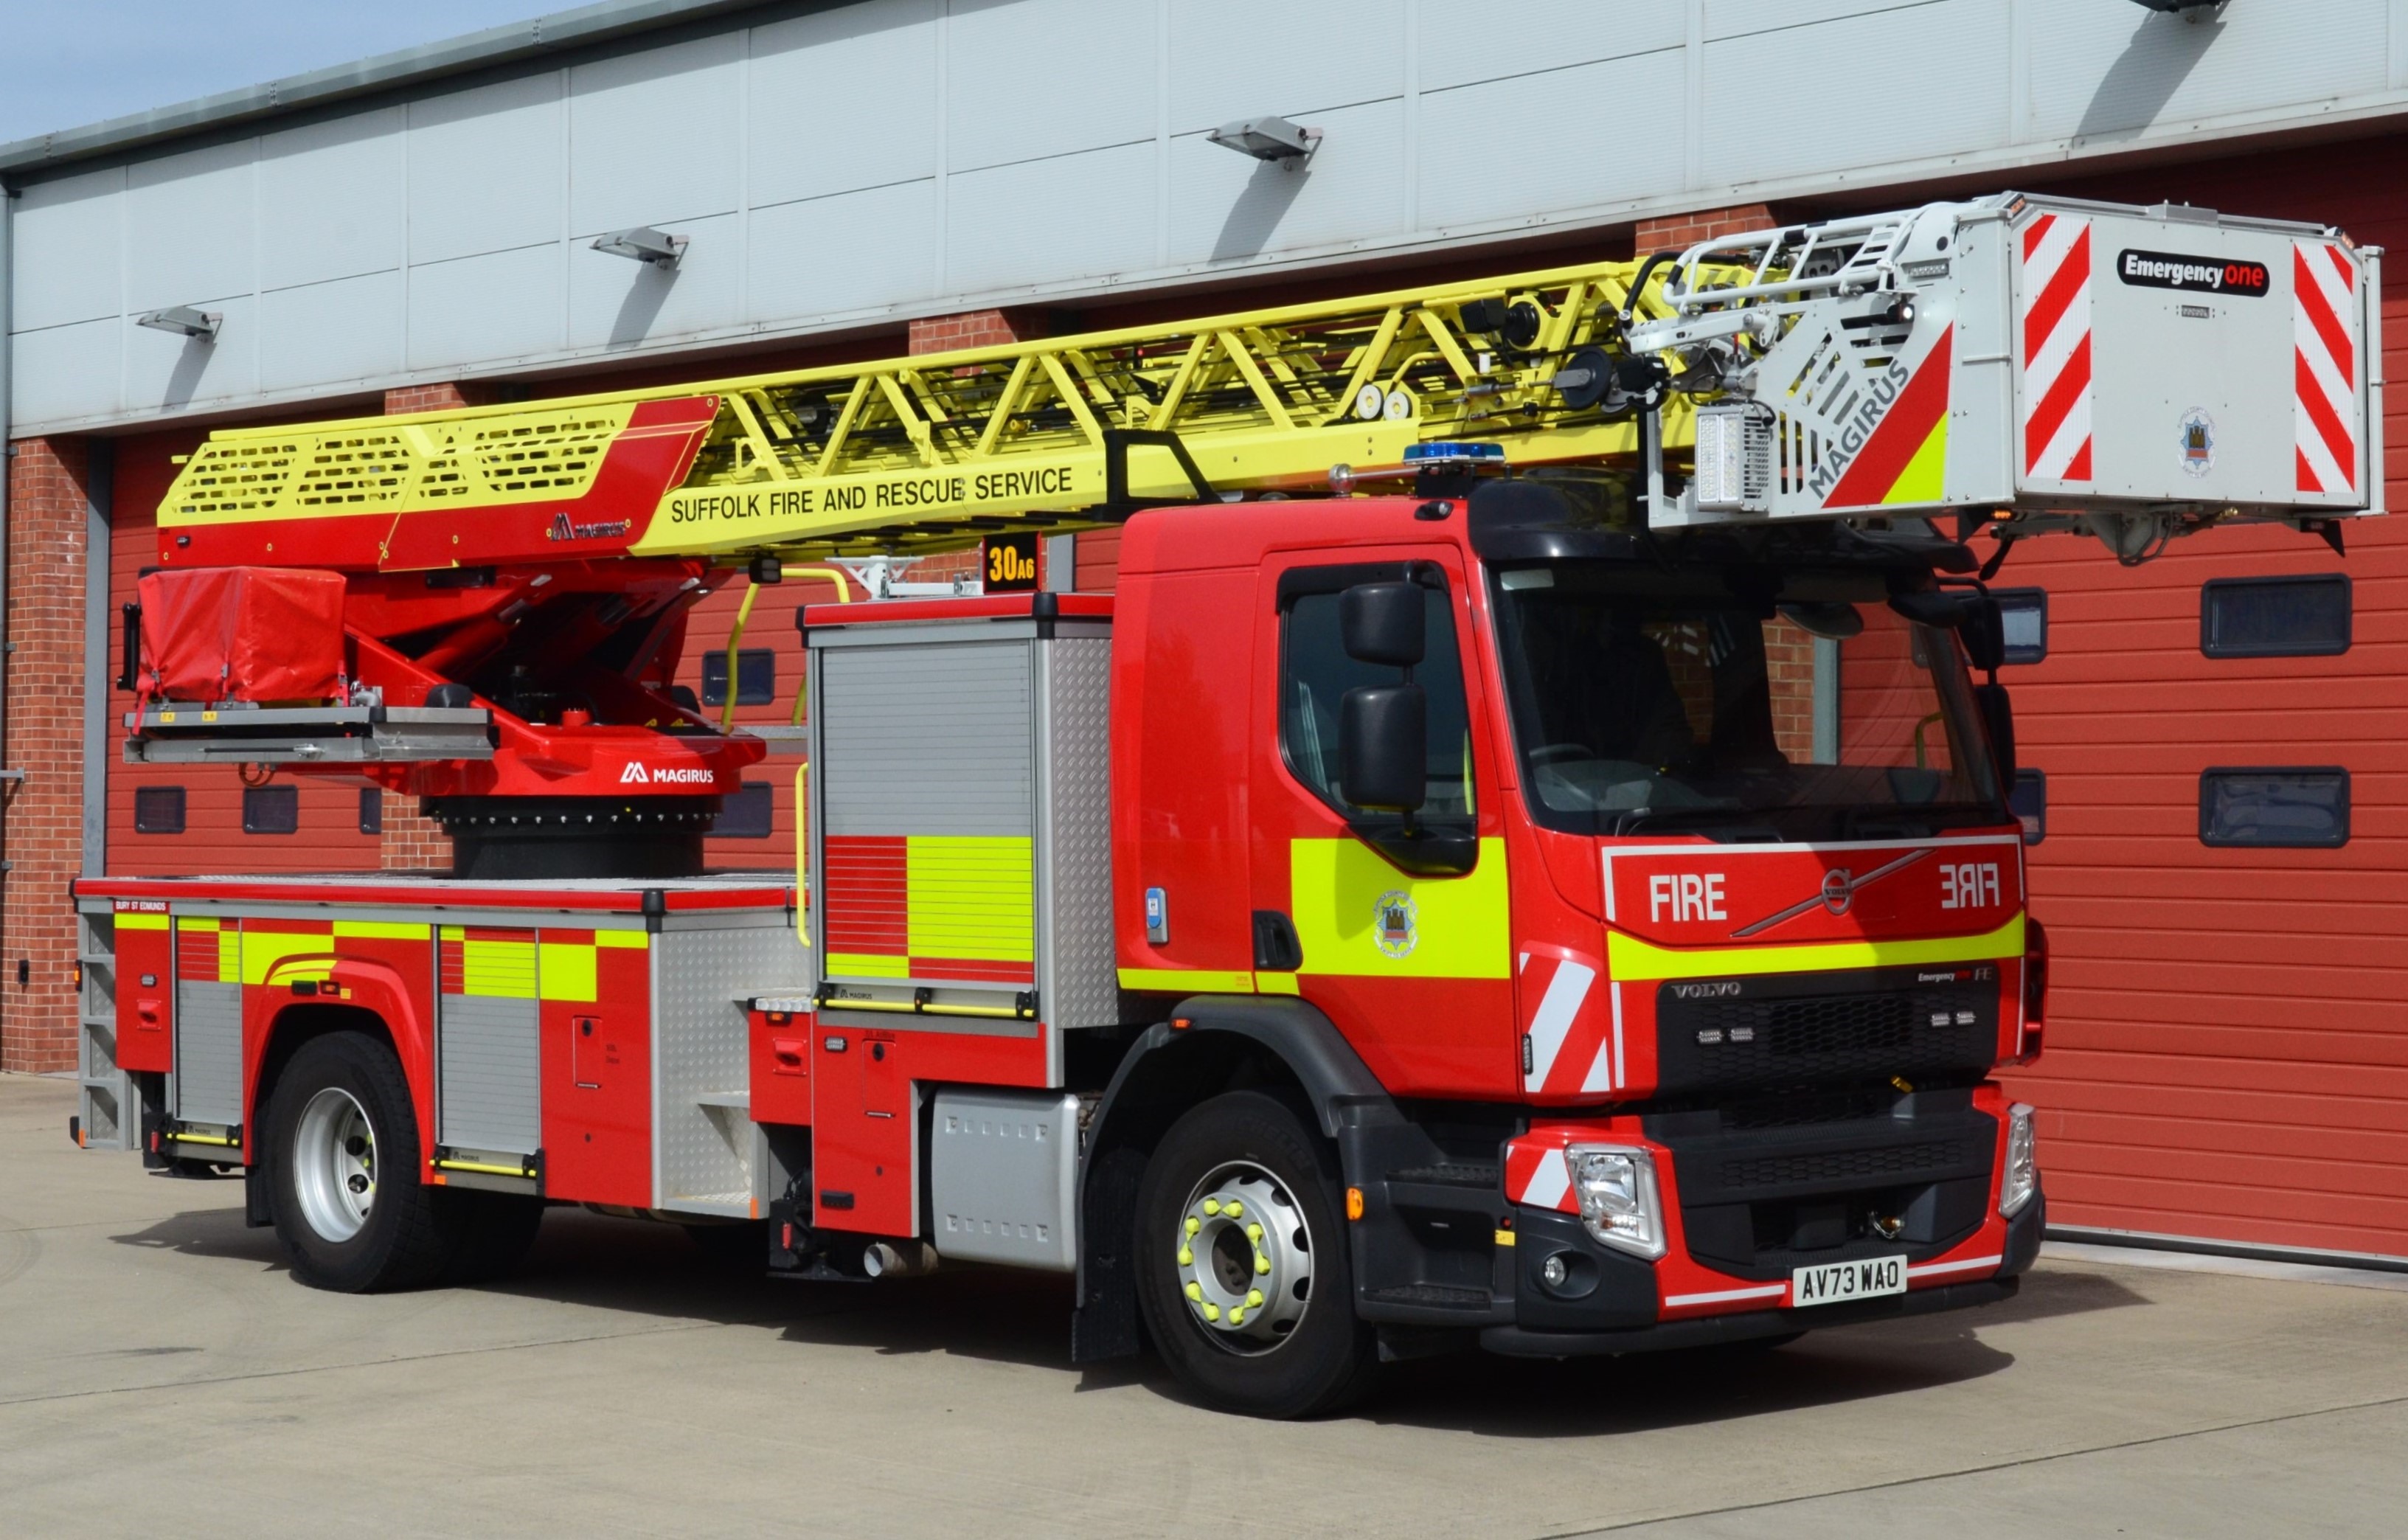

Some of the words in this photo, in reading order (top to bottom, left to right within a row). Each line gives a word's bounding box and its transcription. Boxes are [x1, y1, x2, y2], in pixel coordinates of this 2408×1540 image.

[1808, 358, 1909, 500] MAGIRUS
[672, 494, 760, 523] SUFFOLK
[771, 490, 813, 516] FIRE
[823, 486, 866, 511] AND
[876, 477, 963, 507] RESCUE
[975, 467, 1072, 500] SERVICE
[653, 769, 714, 783] MAGIRUS
[116, 901, 130, 910] BURY
[131, 901, 139, 910] ST
[139, 901, 166, 911] EDMUNDS
[1650, 873, 1727, 923] FIRE
[1975, 967, 1992, 981] FE
[1671, 982, 1741, 999] VOLVO
[1802, 1266, 1854, 1300] AV73
[1861, 1260, 1898, 1291] WAO
